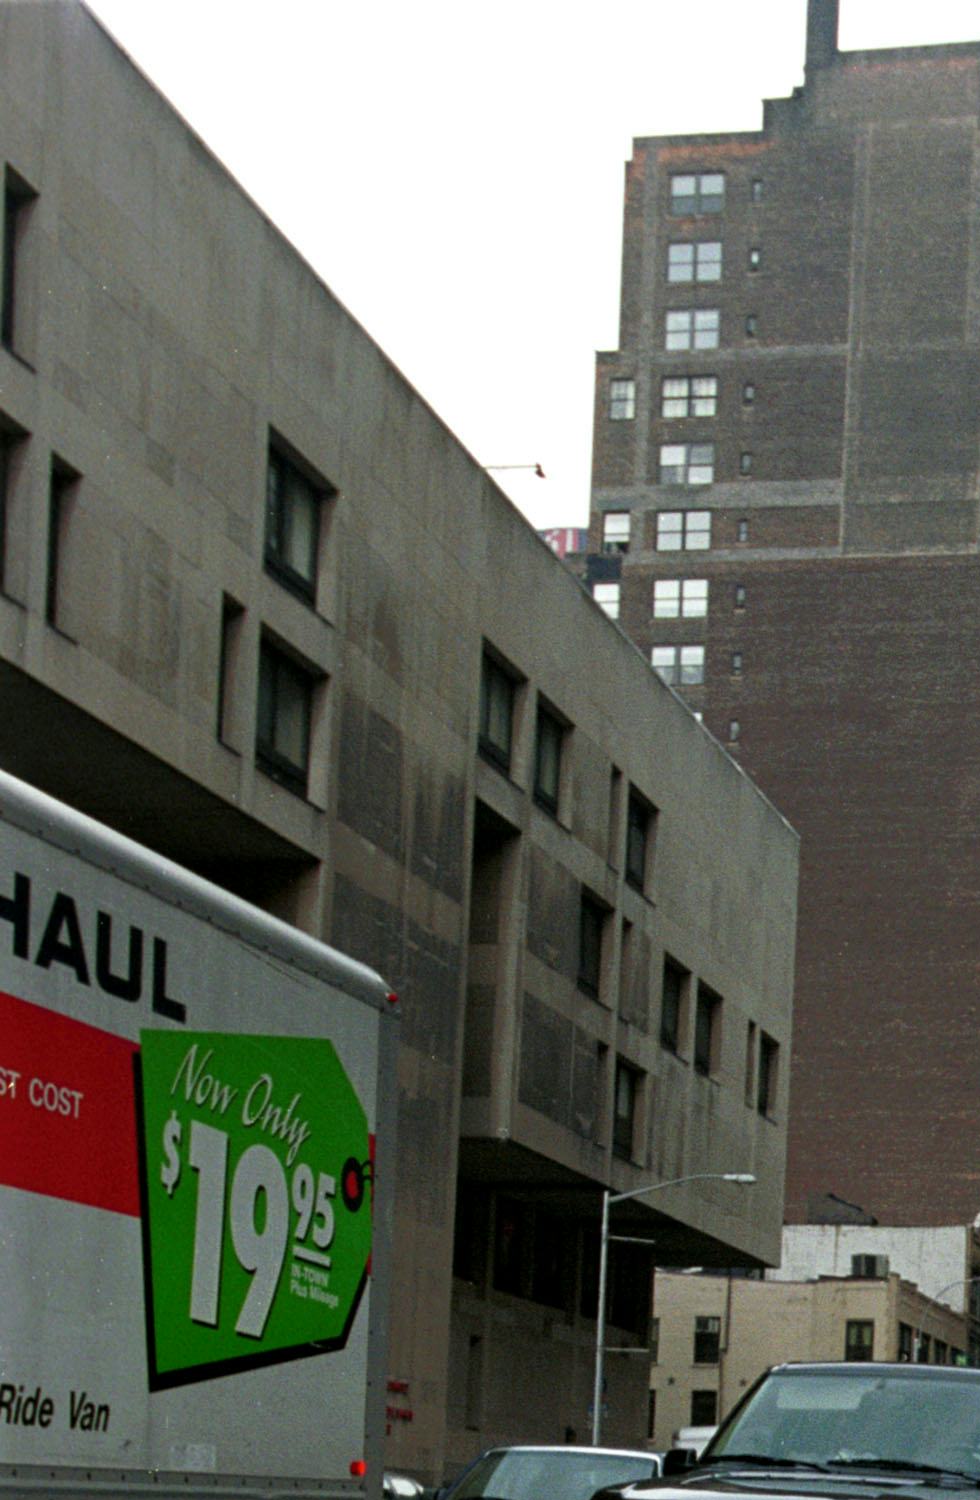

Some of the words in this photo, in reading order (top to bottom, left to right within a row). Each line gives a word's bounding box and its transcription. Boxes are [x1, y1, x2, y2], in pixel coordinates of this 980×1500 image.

[0, 871, 186, 1024] HAUL
[29, 1078, 84, 1119] COST
[170, 1043, 238, 1114] Now
[242, 1073, 311, 1167] Only
[0, 1383, 54, 1428] Ride
[69, 1390, 111, 1433] Van
